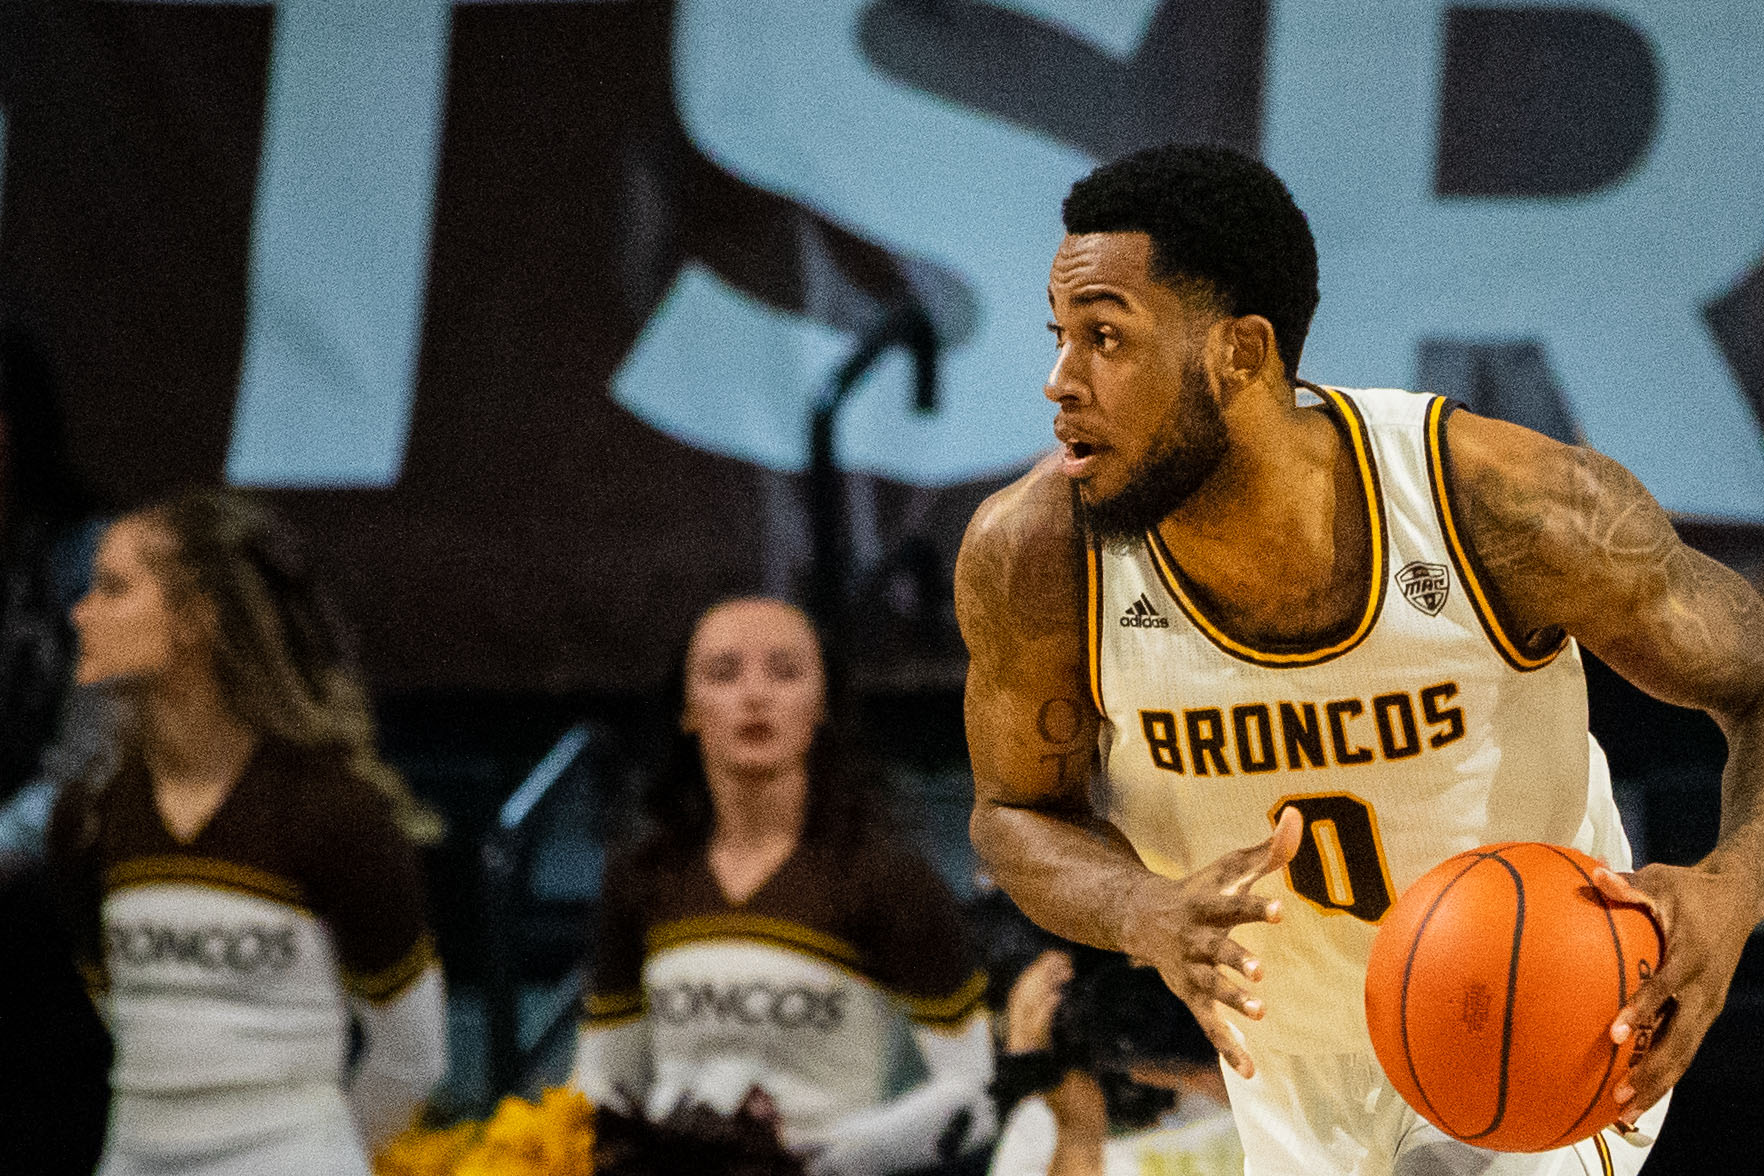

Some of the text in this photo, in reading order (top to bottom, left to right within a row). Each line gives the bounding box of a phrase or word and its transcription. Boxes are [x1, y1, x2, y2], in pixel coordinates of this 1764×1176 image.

[1405, 577, 1448, 598] MAC
[1120, 613, 1169, 629] adidas
[1138, 681, 1465, 777] BRONCOS
[1267, 791, 1398, 927] 0
